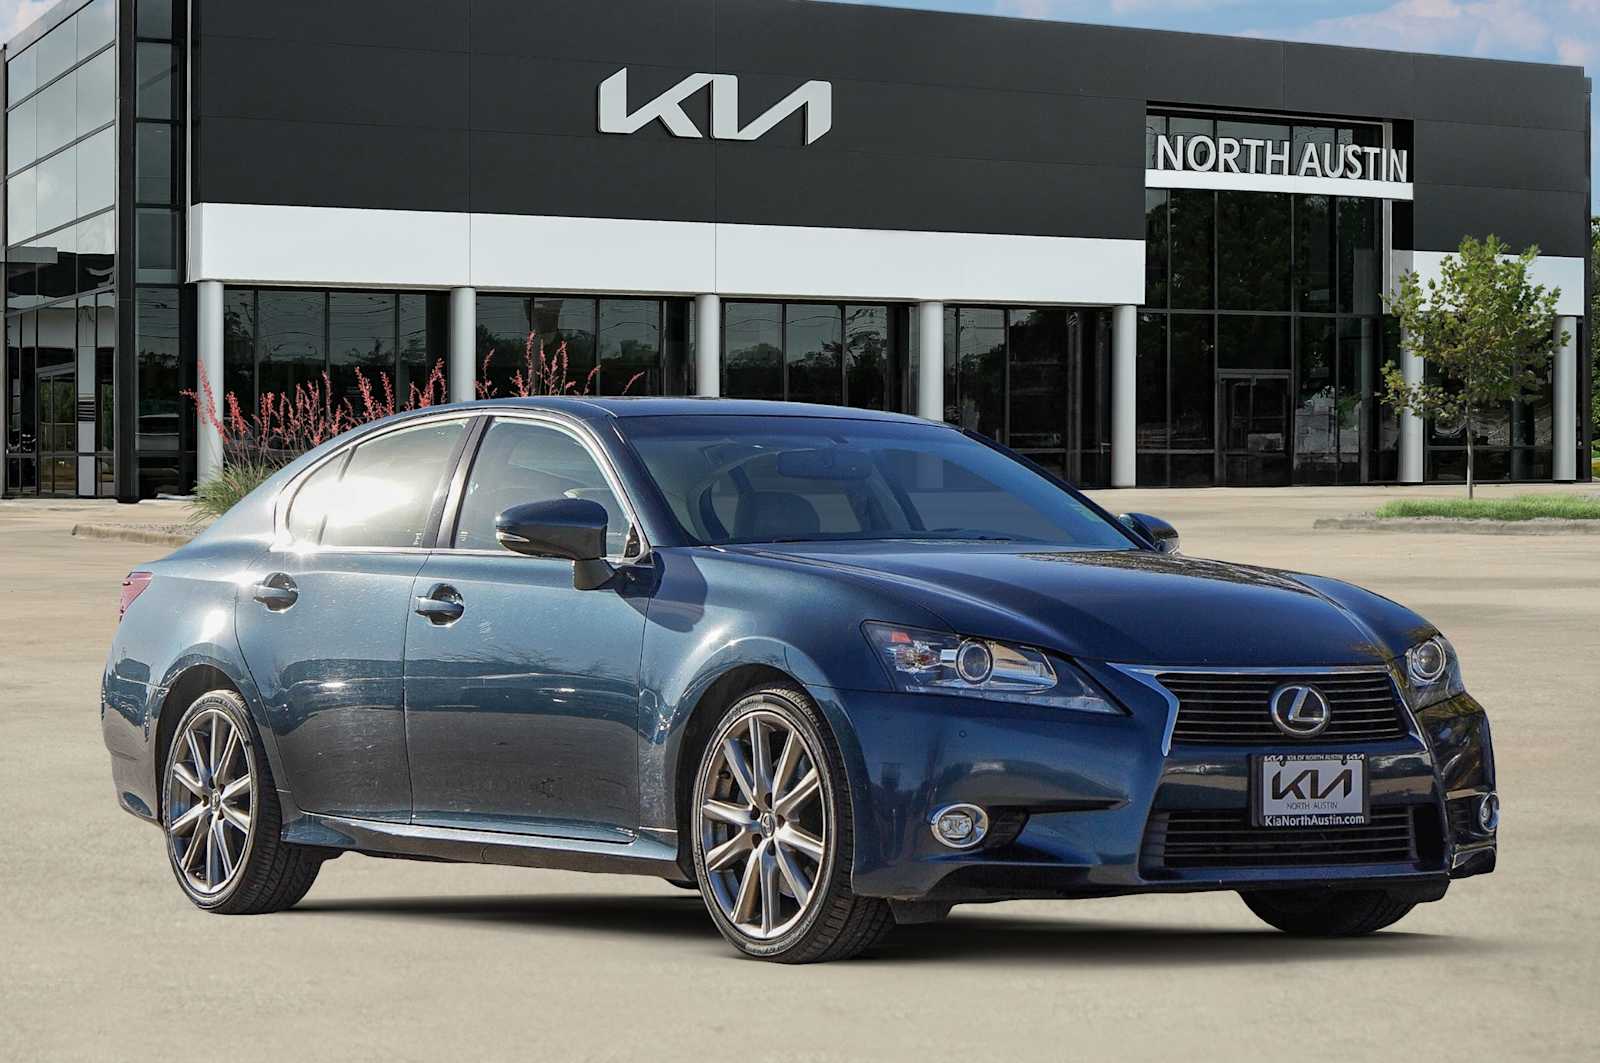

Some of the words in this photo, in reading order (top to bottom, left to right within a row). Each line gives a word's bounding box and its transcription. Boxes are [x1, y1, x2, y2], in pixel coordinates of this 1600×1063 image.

[598, 67, 832, 145] KIA
[1157, 134, 1291, 176] NORTH
[1299, 142, 1408, 183] AUSTIN
[1272, 769, 1352, 800] KIA
[1265, 814, 1365, 827] KiaNorthAustin.com
[1287, 801, 1310, 810] NORTH
[1313, 801, 1338, 809] AUSTIN
